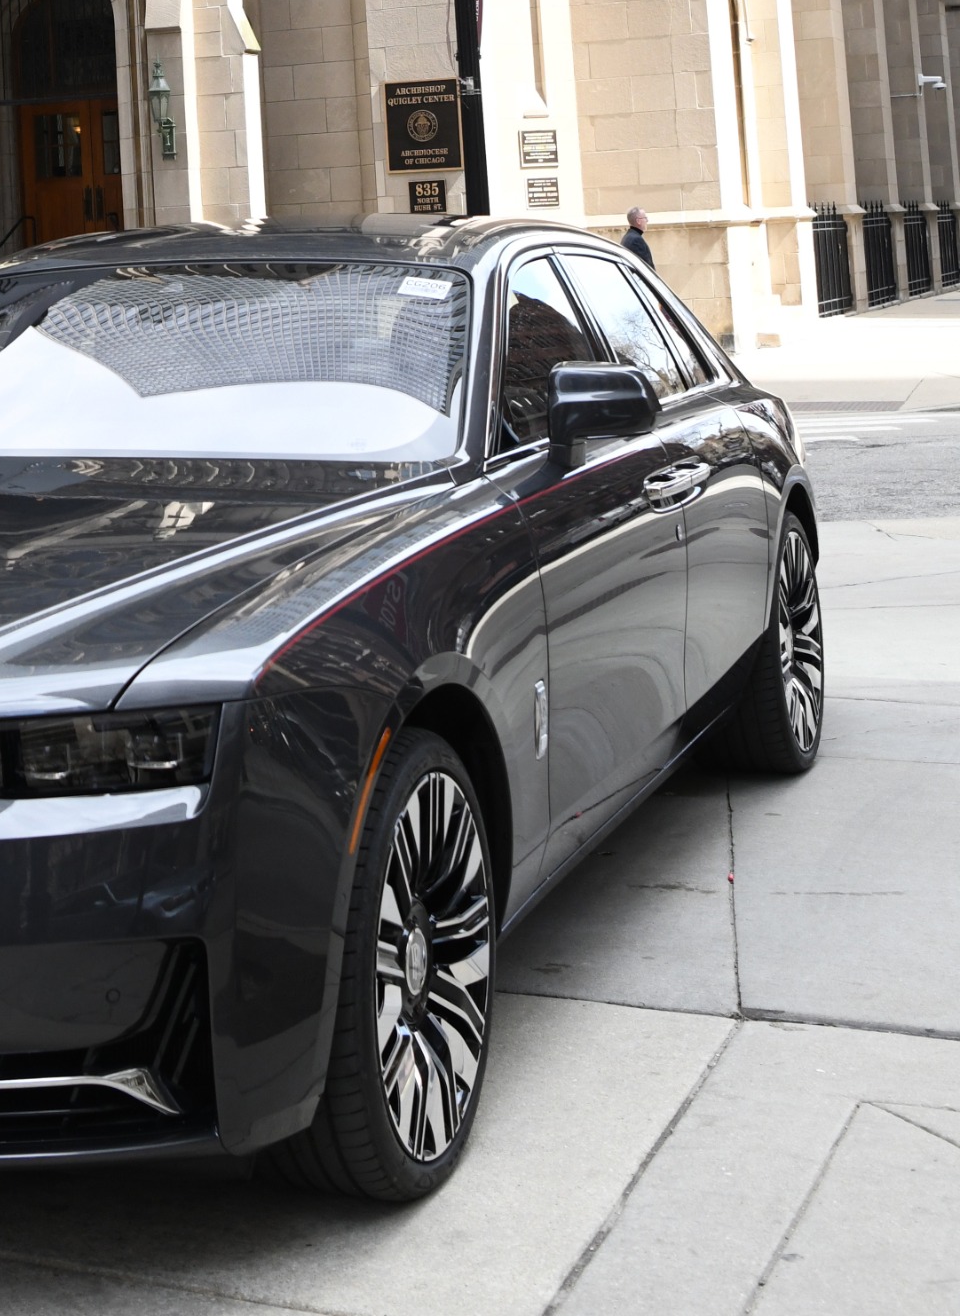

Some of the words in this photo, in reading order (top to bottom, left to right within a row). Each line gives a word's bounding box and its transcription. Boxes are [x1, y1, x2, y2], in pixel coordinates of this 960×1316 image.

[395, 85, 446, 95] ARCHBISHOP
[387, 96, 422, 107] QUIGLEY
[423, 94, 455, 103] CENTER
[401, 148, 449, 157] ARCHDIOCESE
[415, 183, 439, 196] 835
